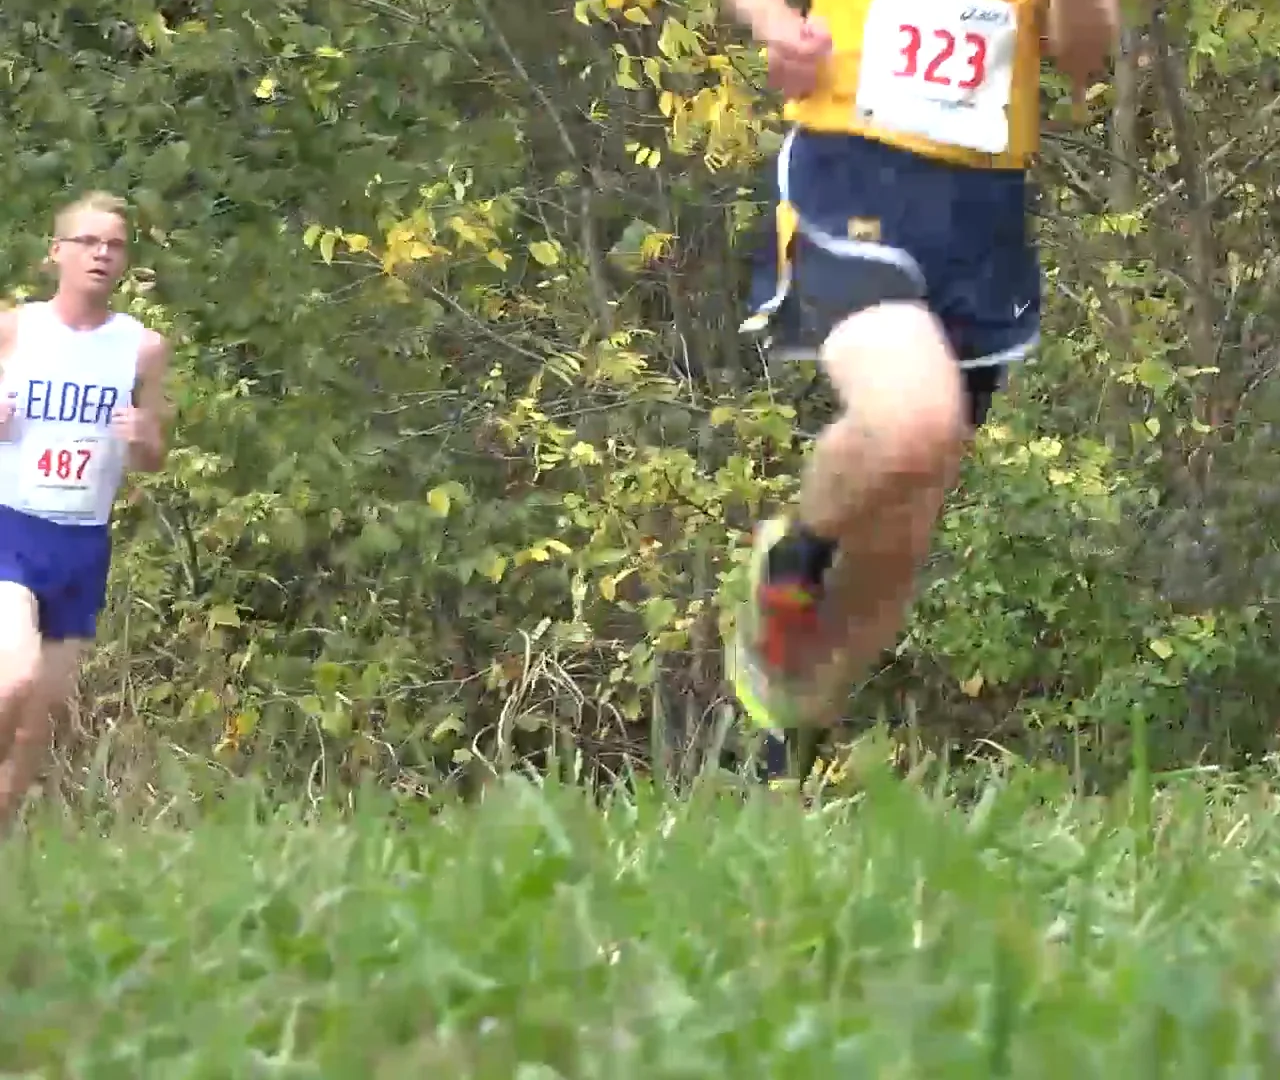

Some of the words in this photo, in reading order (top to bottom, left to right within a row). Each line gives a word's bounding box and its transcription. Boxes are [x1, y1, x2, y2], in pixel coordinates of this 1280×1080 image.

[893, 24, 987, 89] 323
[27, 380, 118, 426] ELDER
[37, 448, 92, 480] 487
